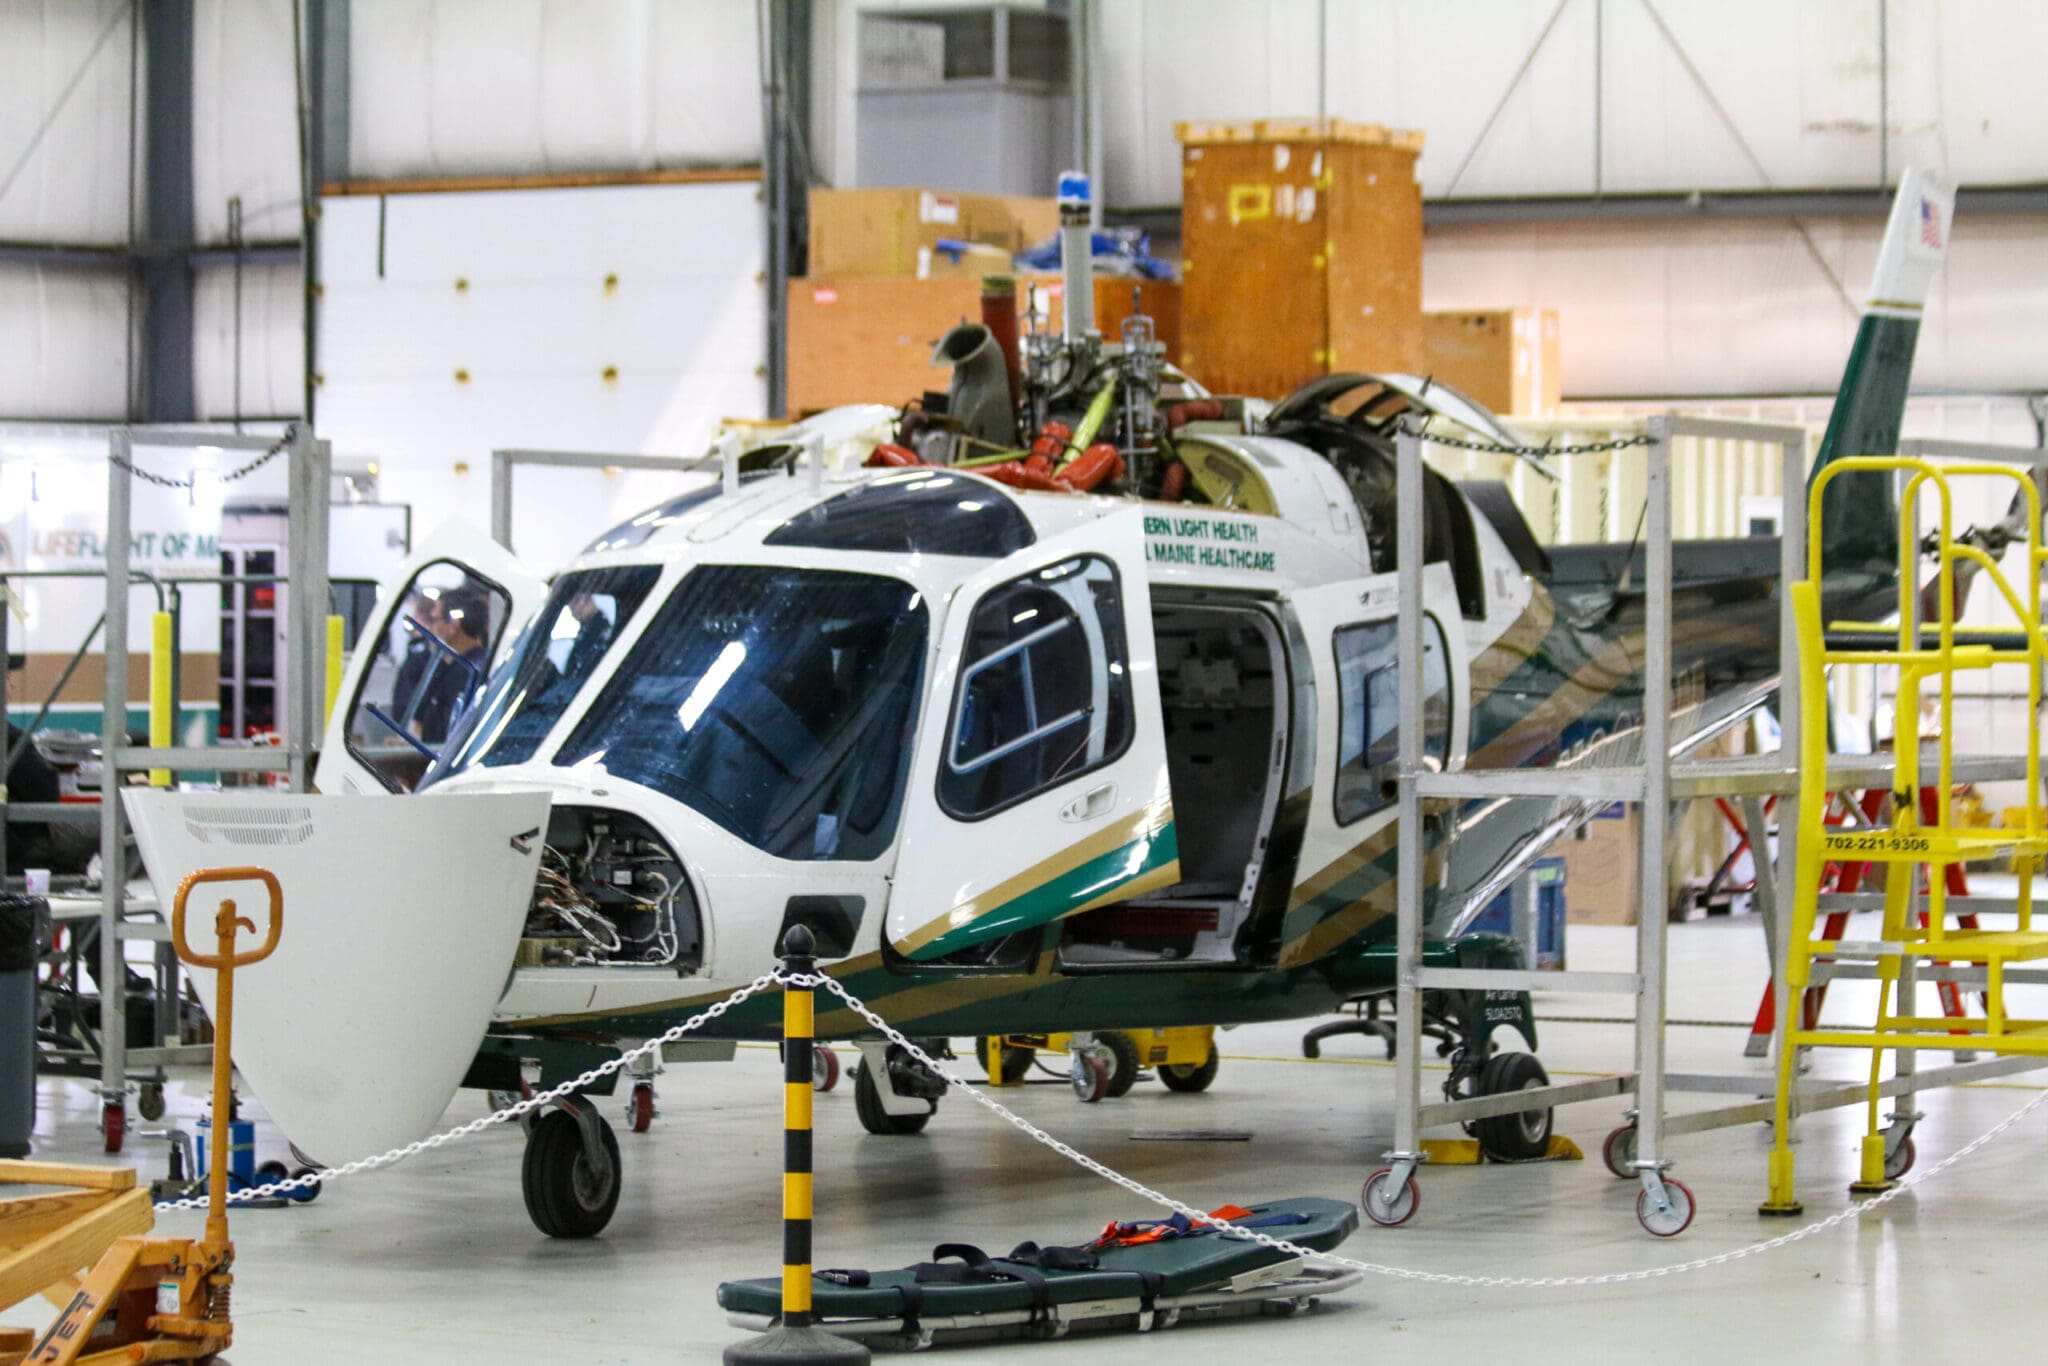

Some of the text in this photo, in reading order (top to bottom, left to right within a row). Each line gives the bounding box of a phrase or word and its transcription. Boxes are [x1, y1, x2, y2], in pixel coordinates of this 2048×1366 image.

[1174, 517, 1209, 539] LIGHT
[1213, 521, 1258, 542] HEALTH
[32, 530, 156, 557] LIFEFLHT
[161, 532, 191, 558] OF
[1154, 543, 1196, 565] MAINE
[1199, 547, 1276, 571] HEALTHCARE
[1826, 837, 1929, 851] 702-221-9306
[41, 1294, 95, 1364] JET
